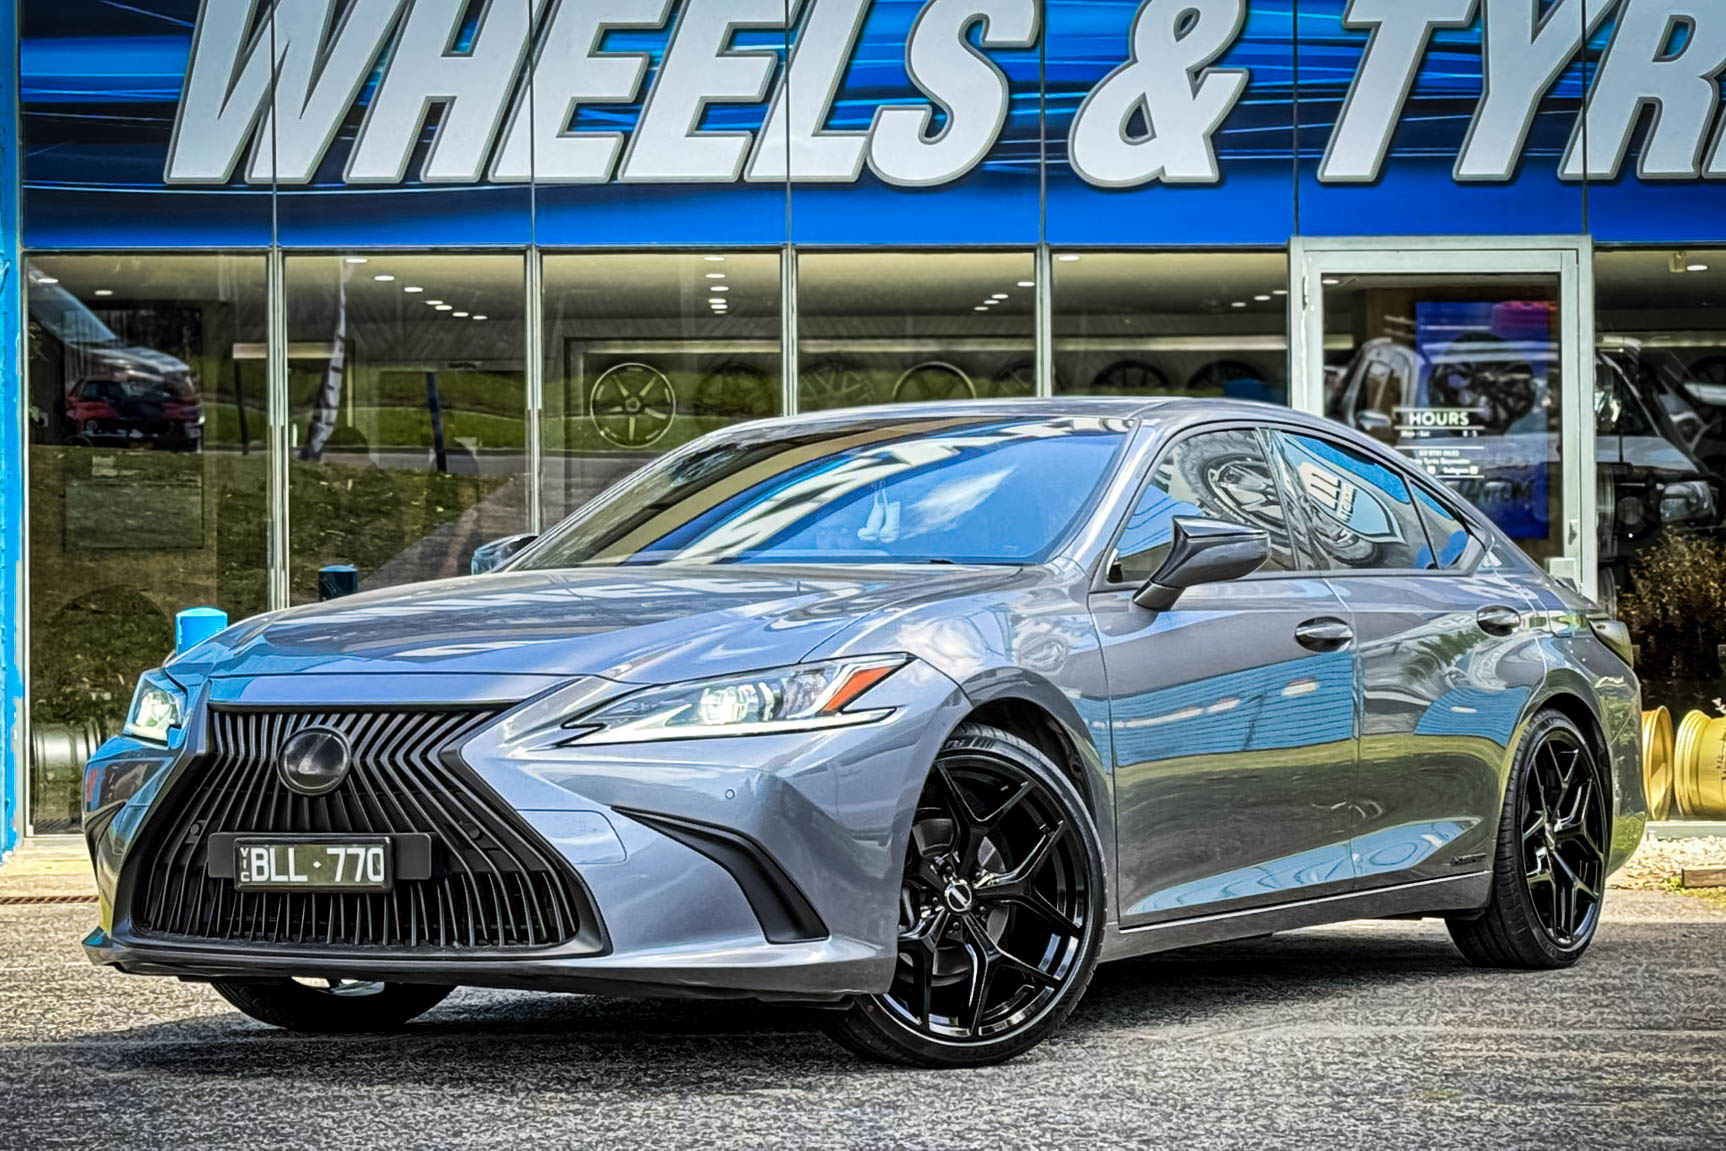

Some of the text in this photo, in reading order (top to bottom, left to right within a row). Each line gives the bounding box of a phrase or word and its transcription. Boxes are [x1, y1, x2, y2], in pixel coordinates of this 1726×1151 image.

[165, 0, 1726, 187] WHEELS & TYR
[1408, 412, 1470, 426] HOURS
[240, 847, 250, 883] VIC
[326, 847, 384, 883] 770
